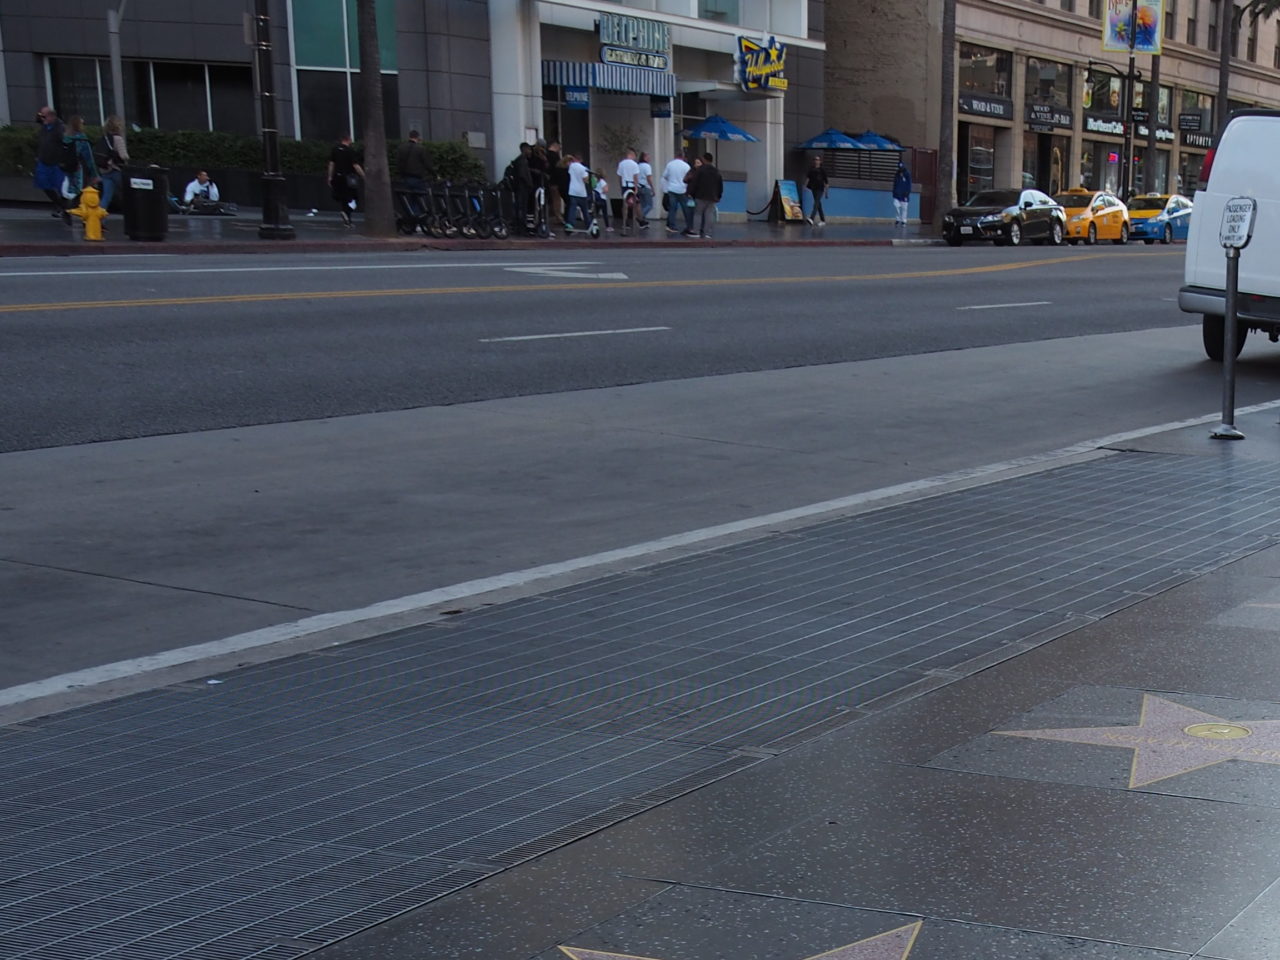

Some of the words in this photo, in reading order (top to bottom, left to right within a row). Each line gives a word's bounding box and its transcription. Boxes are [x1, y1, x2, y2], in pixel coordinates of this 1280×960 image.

[600, 12, 671, 52] DELPHINE
[1226, 203, 1252, 213] PASSENGER
[1226, 214, 1246, 223] LOADING
